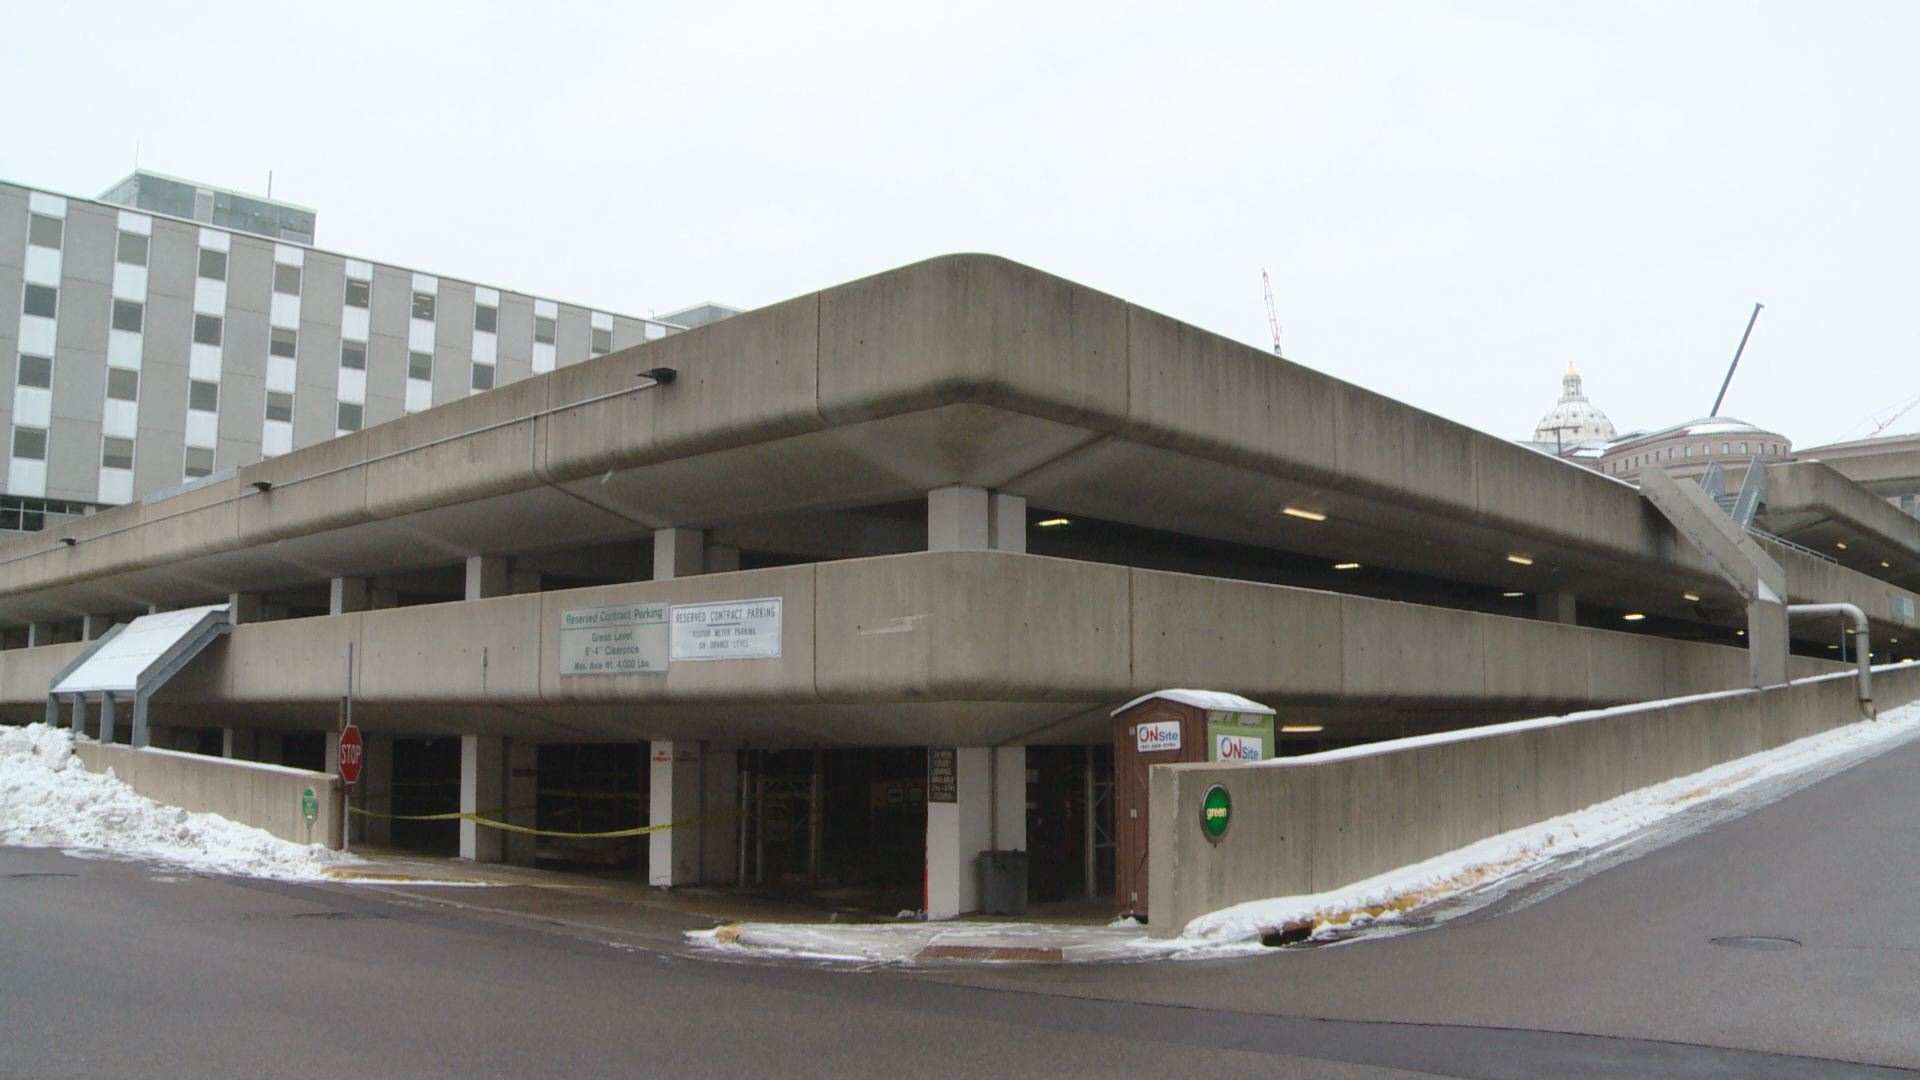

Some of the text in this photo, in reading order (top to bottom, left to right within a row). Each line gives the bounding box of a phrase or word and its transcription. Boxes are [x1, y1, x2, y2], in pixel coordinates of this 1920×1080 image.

[566, 608, 662, 624] Reserved Contract Parking
[676, 607, 775, 624] RESERVED CONTRACT PARKING
[592, 631, 633, 642] Green Level
[715, 628, 730, 637] METER
[734, 627, 756, 636] PARKING
[605, 645, 639, 655] Clearance
[340, 744, 361, 765] STOP
[1206, 807, 1227, 820] green
